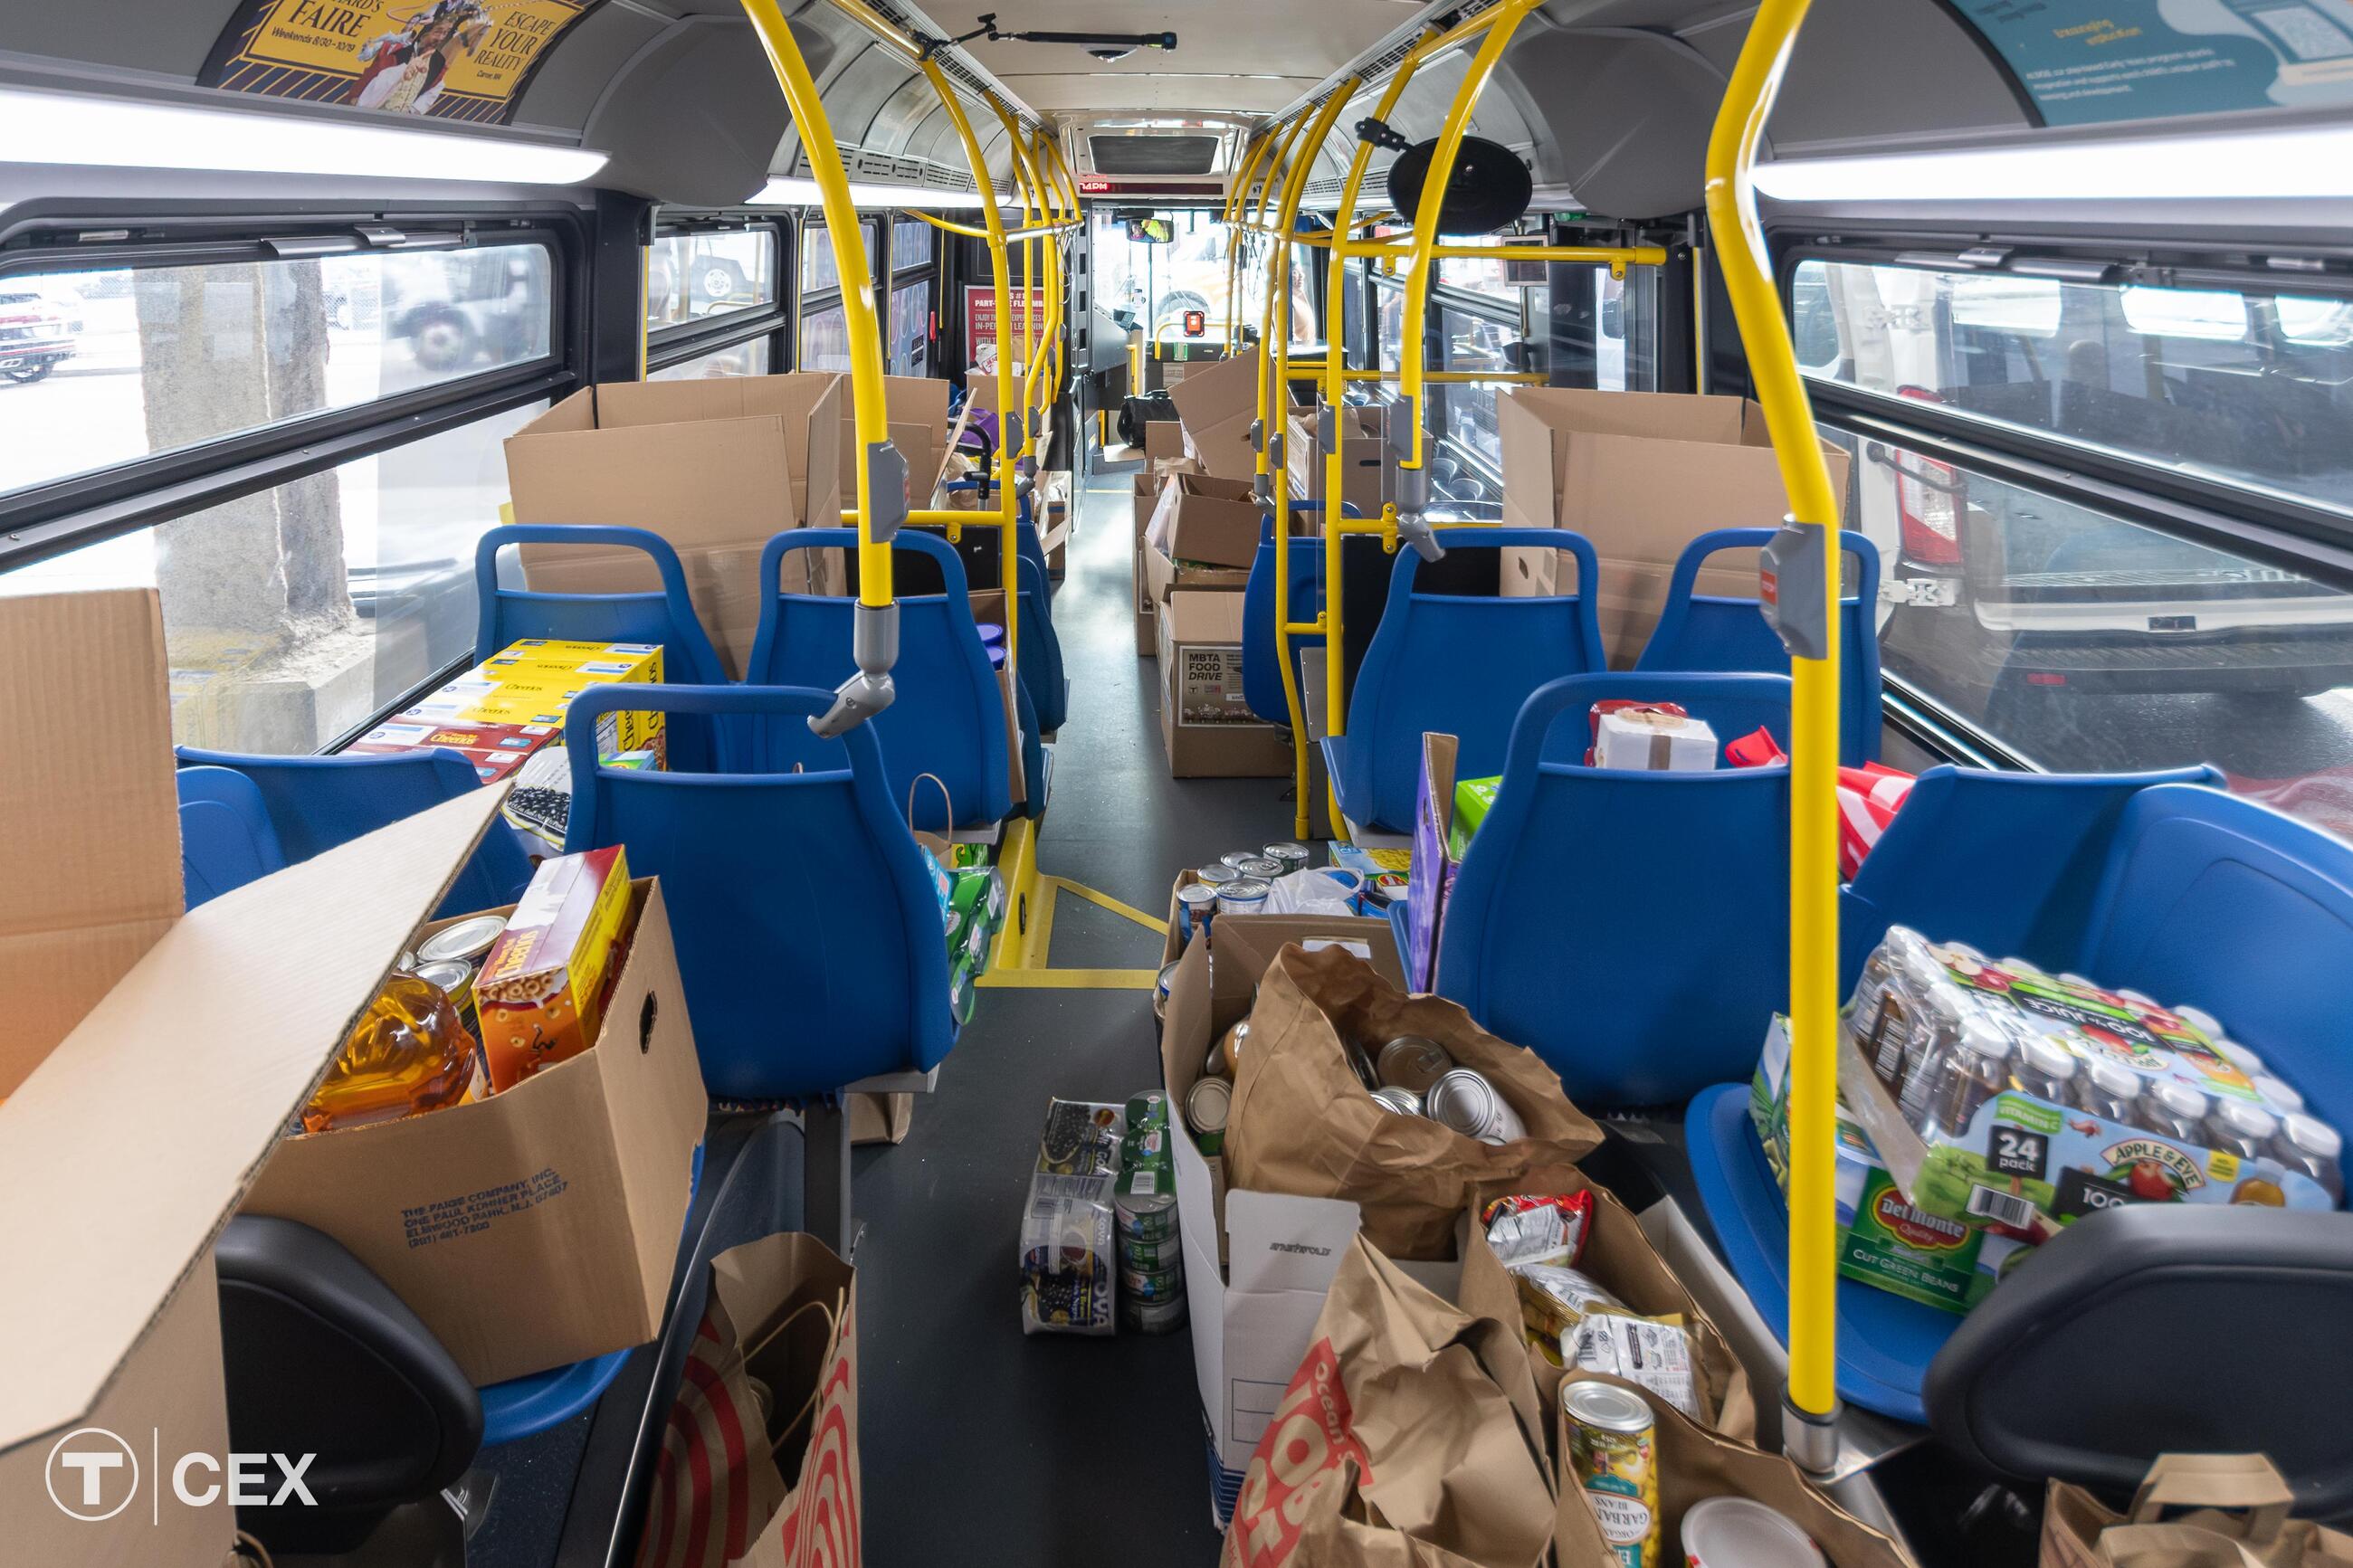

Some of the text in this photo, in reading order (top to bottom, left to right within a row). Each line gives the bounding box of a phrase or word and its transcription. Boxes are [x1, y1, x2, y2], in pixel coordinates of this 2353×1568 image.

[288, 0, 371, 37] FAIRE
[504, 11, 557, 36] ESCAPE
[272, 26, 313, 43] Weekends
[490, 28, 538, 55] YOUR
[473, 50, 521, 71] REALITY
[1188, 653, 1221, 662] MBTA
[1189, 662, 1221, 671] FOOD
[1188, 672, 1223, 680] DRIVE
[430, 734, 477, 746] Cheerios
[1998, 1133, 2038, 1161] 24
[1998, 1157, 2036, 1172] pack
[2114, 1142, 2162, 1164] APPLE
[2163, 1148, 2174, 1163] &
[2173, 1155, 2200, 1187] EVE
[402, 1206, 426, 1219] THE
[429, 1196, 466, 1213] PAIGE
[405, 1215, 430, 1229] ONE
[433, 1207, 464, 1222] PAUL
[520, 1174, 562, 1199] PLACE
[1881, 1196, 1965, 1238] Del Monte
[1899, 1222, 1935, 1243] Quality
[1853, 1249, 1879, 1264] CUT
[1880, 1257, 1919, 1279] GREEN
[1920, 1272, 1960, 1293] BEANS
[1093, 1281, 1109, 1326] OYA
[1315, 1361, 1348, 1445] Ocean
[1594, 1496, 1629, 1511] BEANS
